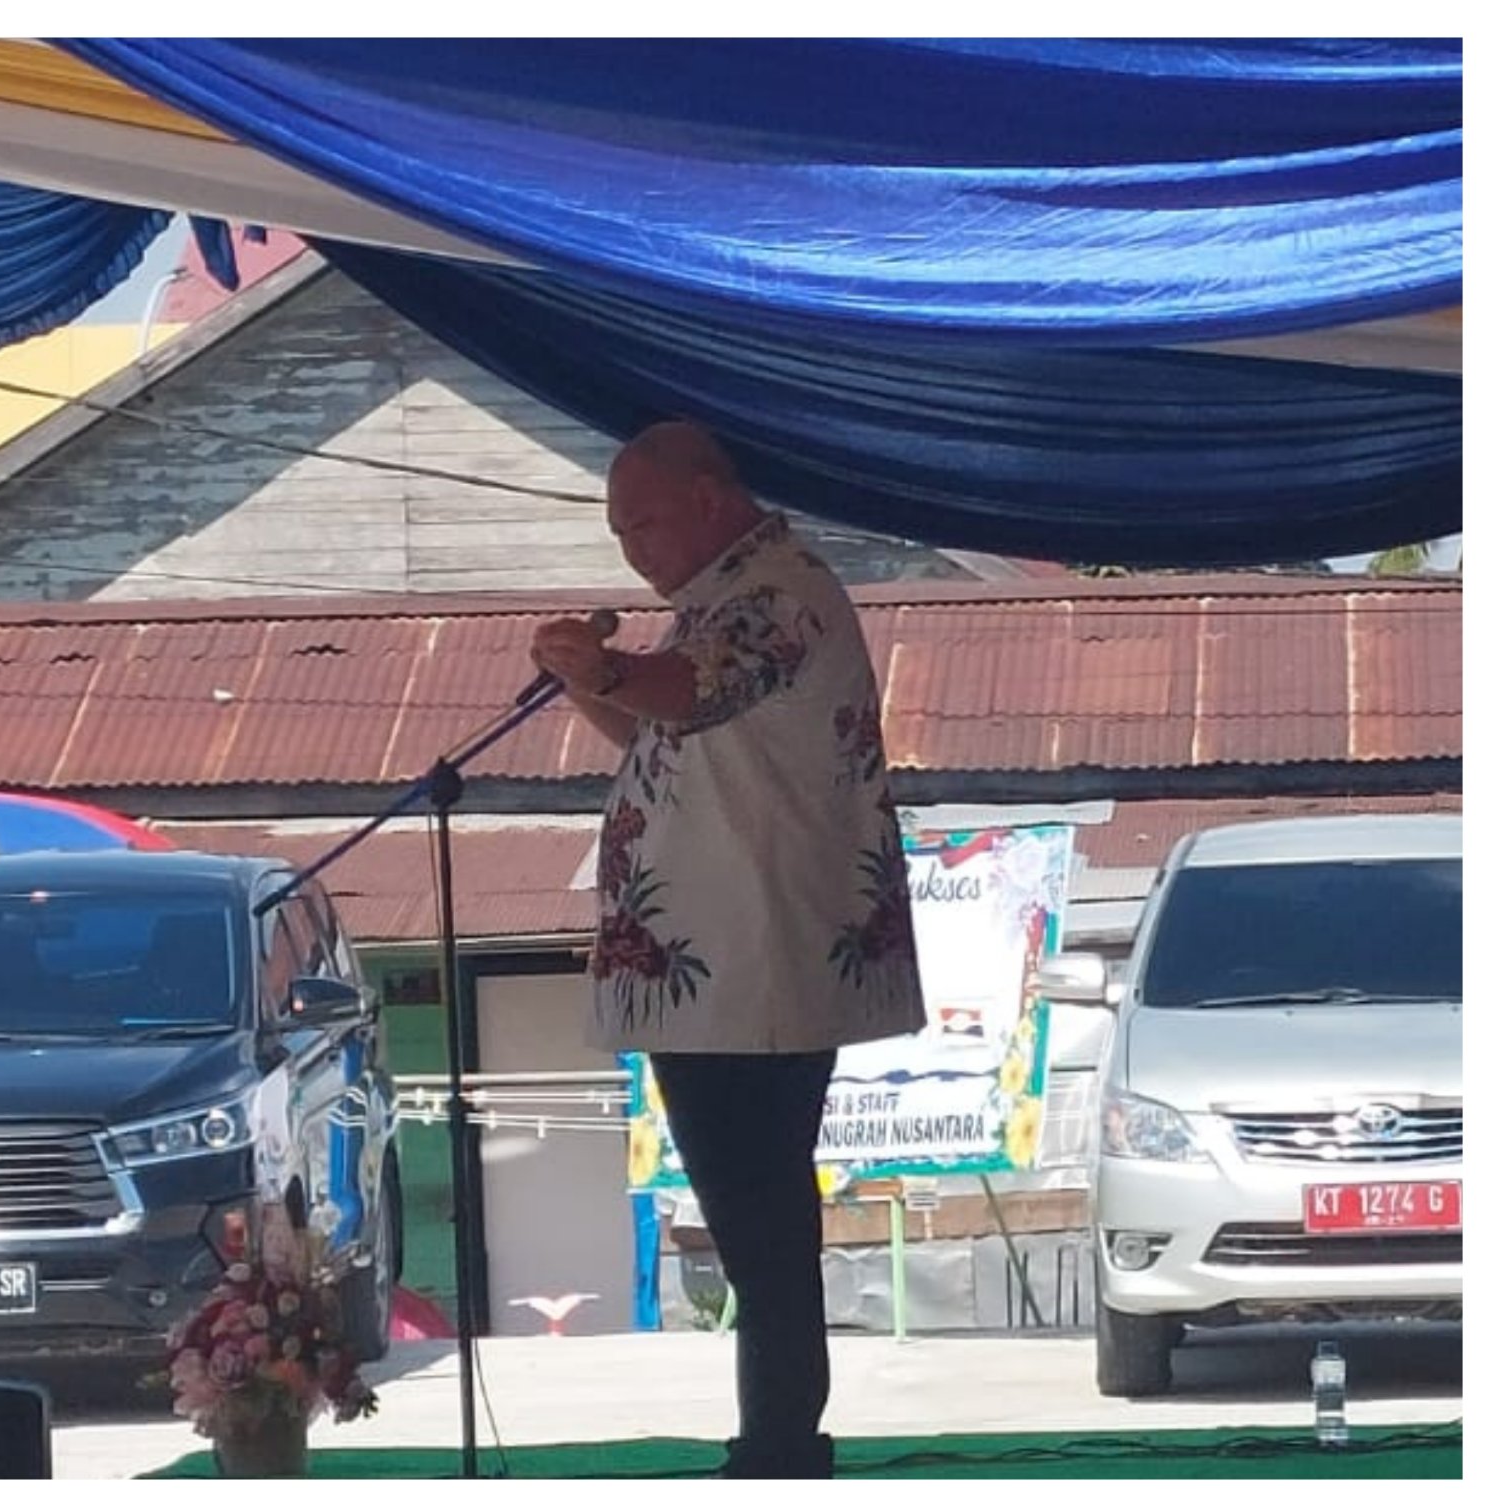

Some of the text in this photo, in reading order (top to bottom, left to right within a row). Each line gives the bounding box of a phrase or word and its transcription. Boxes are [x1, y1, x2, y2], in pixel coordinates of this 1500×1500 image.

[904, 859, 981, 902] ukses
[819, 1112, 984, 1148] NUGRAH NUSANTARA
[1315, 1186, 1341, 1216] KT
[0, 1267, 26, 1296] SR
